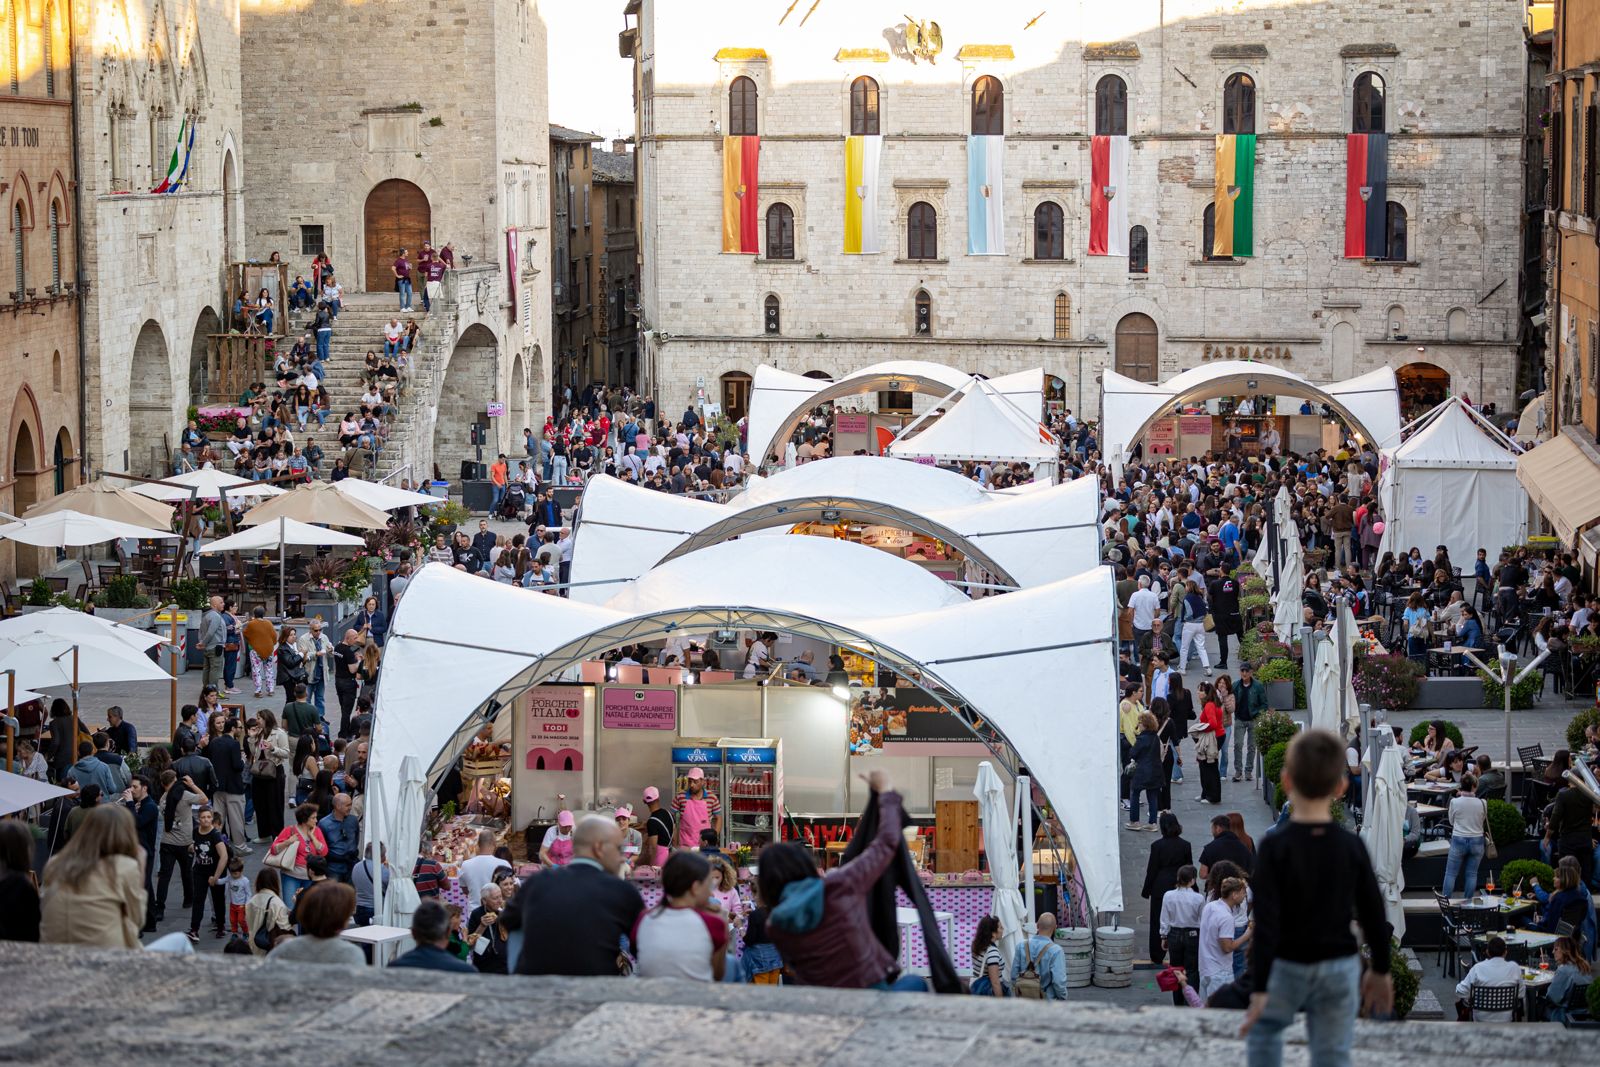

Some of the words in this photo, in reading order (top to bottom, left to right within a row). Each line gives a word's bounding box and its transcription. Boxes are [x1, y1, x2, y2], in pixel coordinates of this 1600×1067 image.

[0, 126, 7, 147] E
[11, 126, 19, 147] DI
[22, 127, 39, 147] TODI
[1202, 343, 1293, 361] FARMACIA
[531, 699, 579, 708] PORCHET
[605, 704, 639, 712] PORCHETTA
[640, 705, 673, 713] CALABRESE
